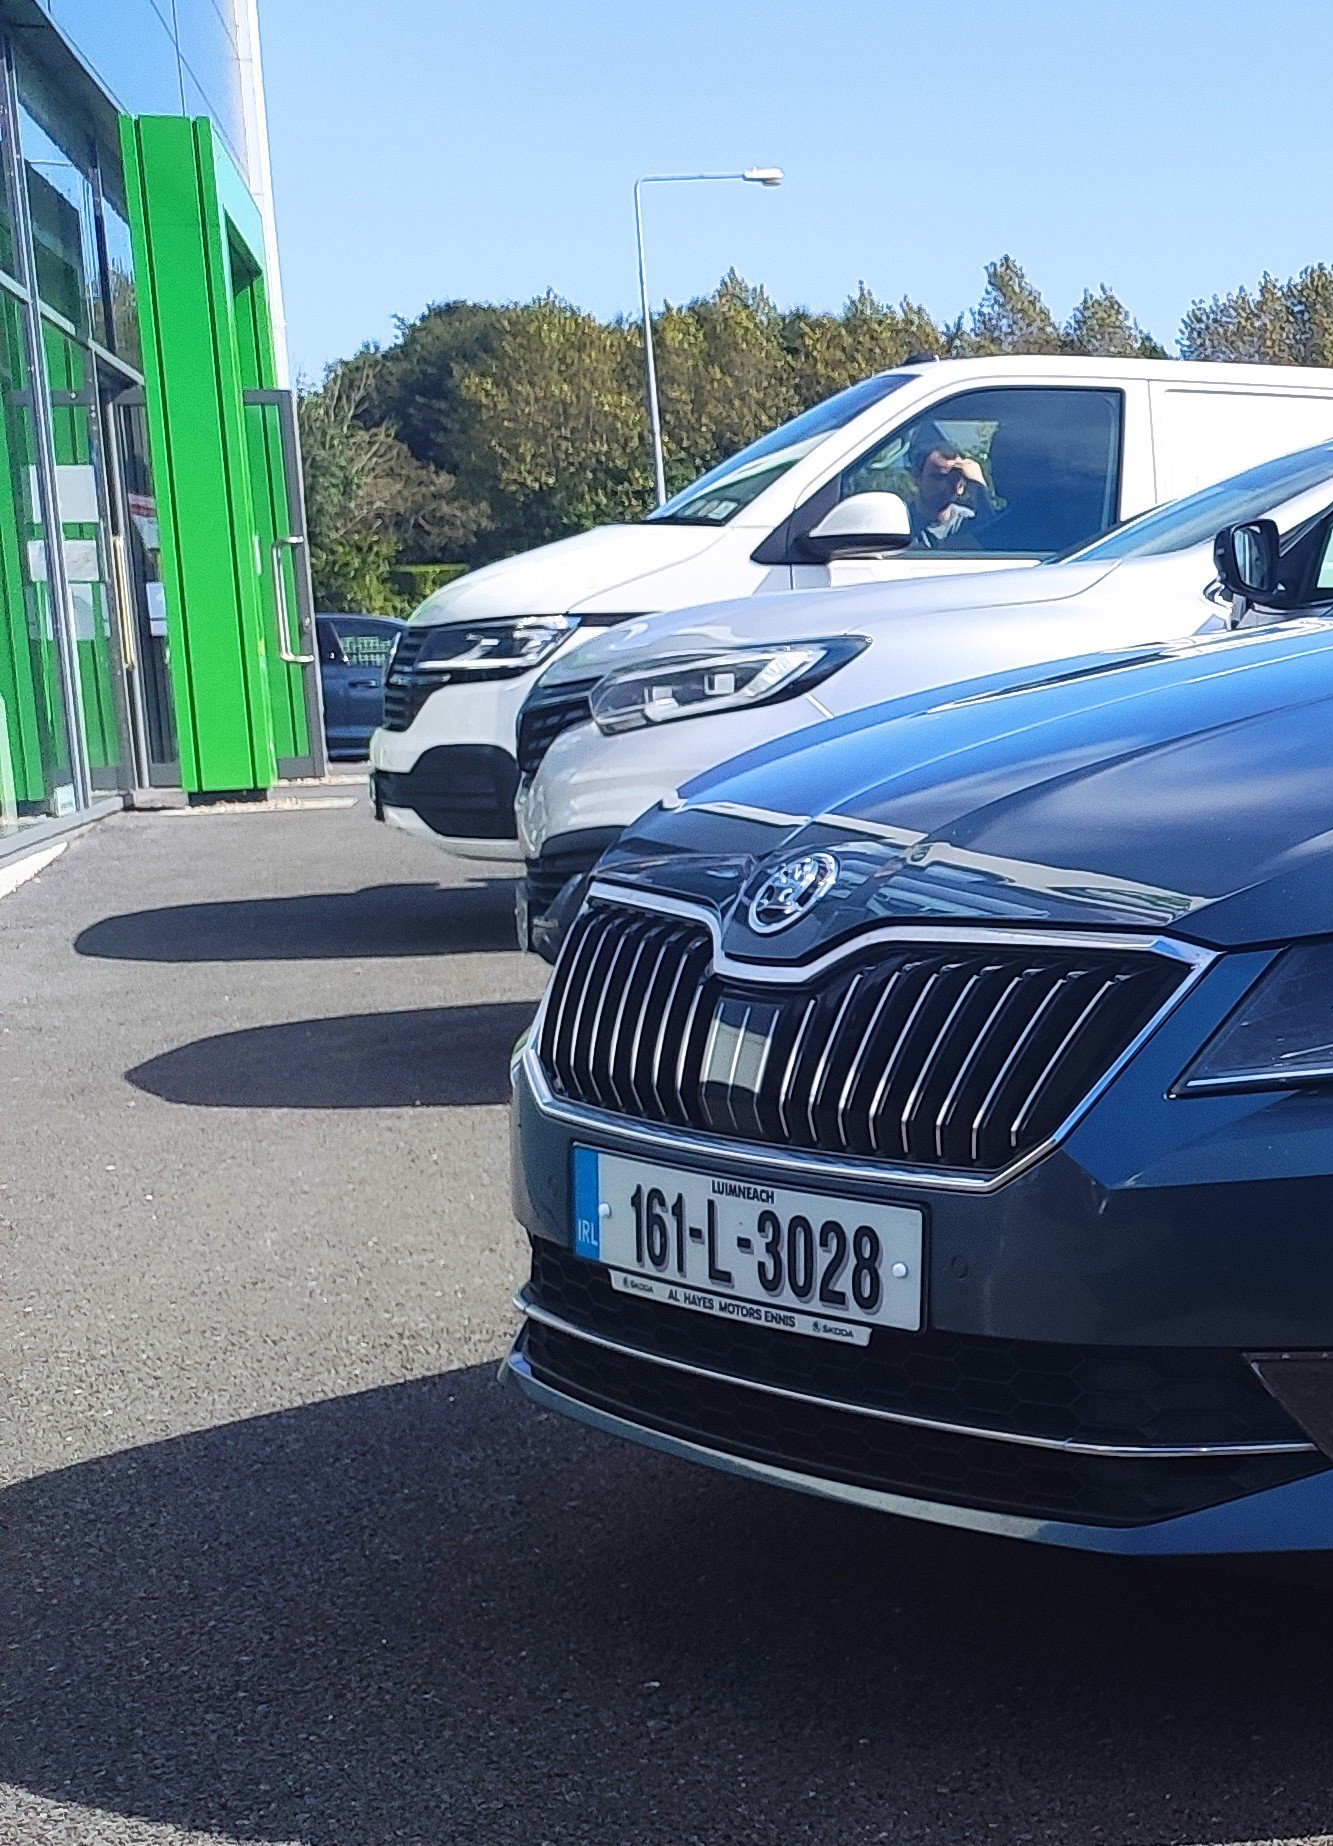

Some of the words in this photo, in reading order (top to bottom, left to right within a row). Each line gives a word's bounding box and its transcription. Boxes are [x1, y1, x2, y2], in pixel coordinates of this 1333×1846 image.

[711, 1179, 775, 1205] LUIMNEACH
[577, 1219, 599, 1247] IRL
[630, 1183, 882, 1313] 161-L-3028
[667, 1288, 680, 1302] AL
[683, 1291, 715, 1311] HAYES
[718, 1300, 763, 1322] MOTORS
[764, 1309, 796, 1328] ENNIS
